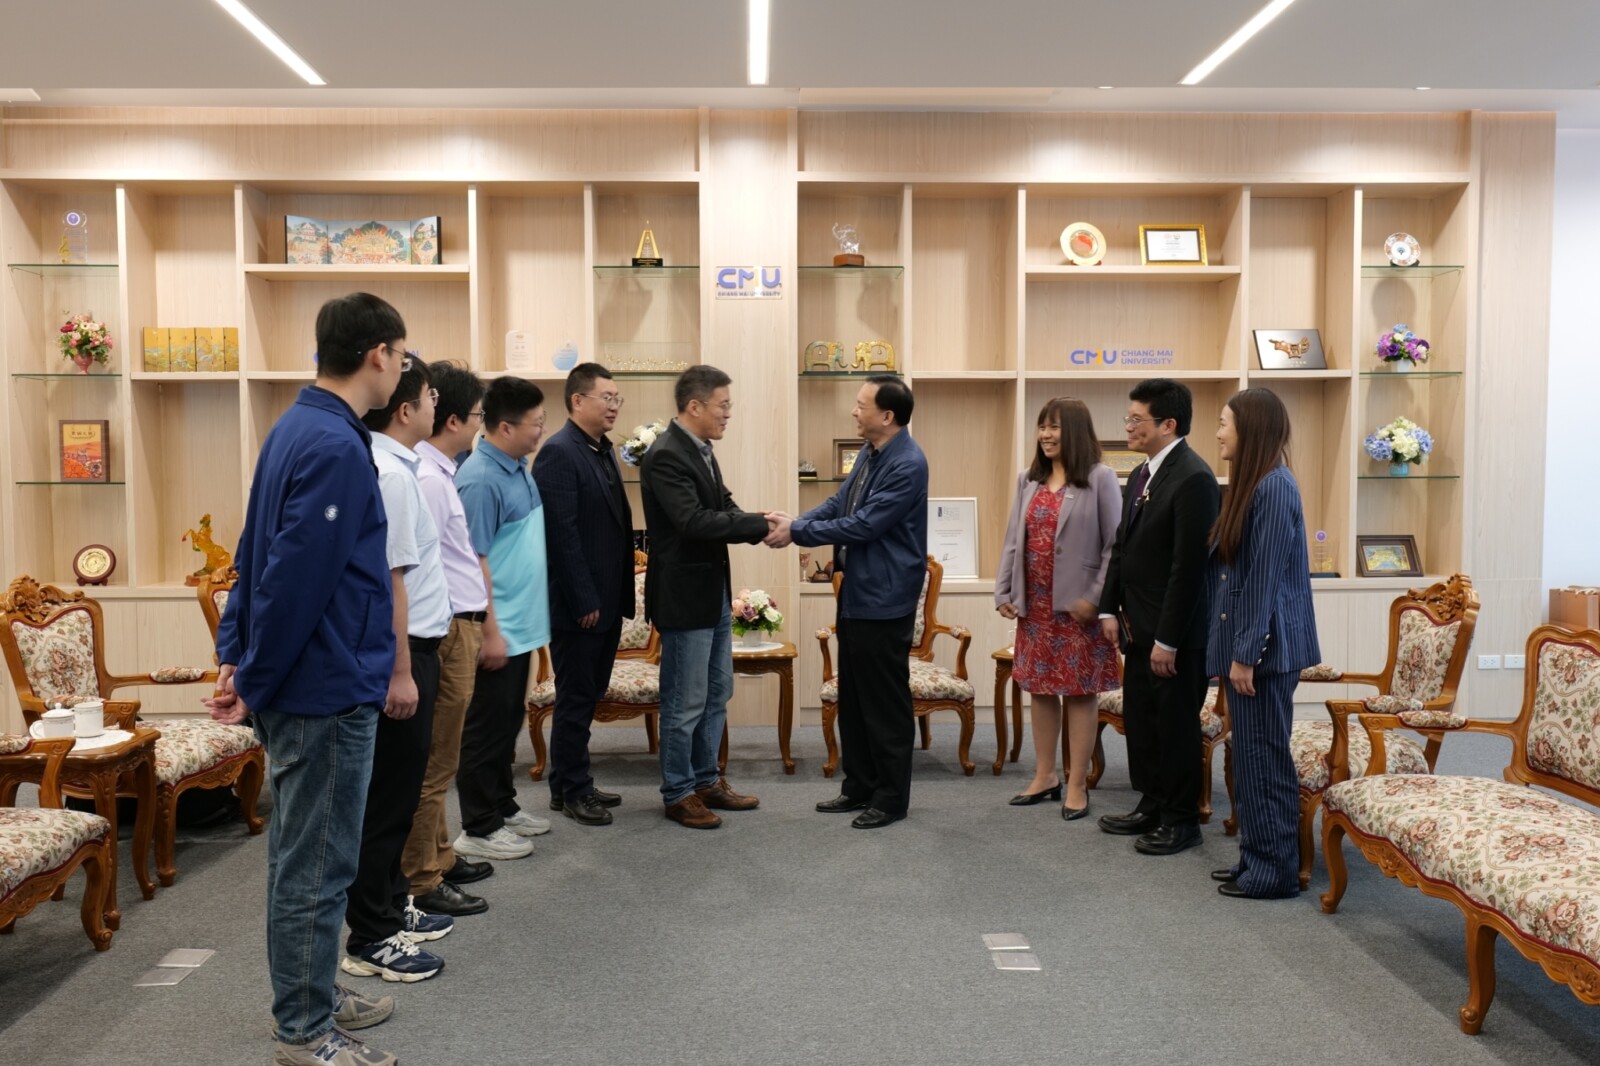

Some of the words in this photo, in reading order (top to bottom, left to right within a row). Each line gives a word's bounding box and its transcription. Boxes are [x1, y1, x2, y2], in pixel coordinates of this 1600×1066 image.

[717, 268, 781, 289] CMU
[1070, 349, 1118, 365] CMU
[371, 945, 404, 965] N
[312, 1042, 338, 1062] N
